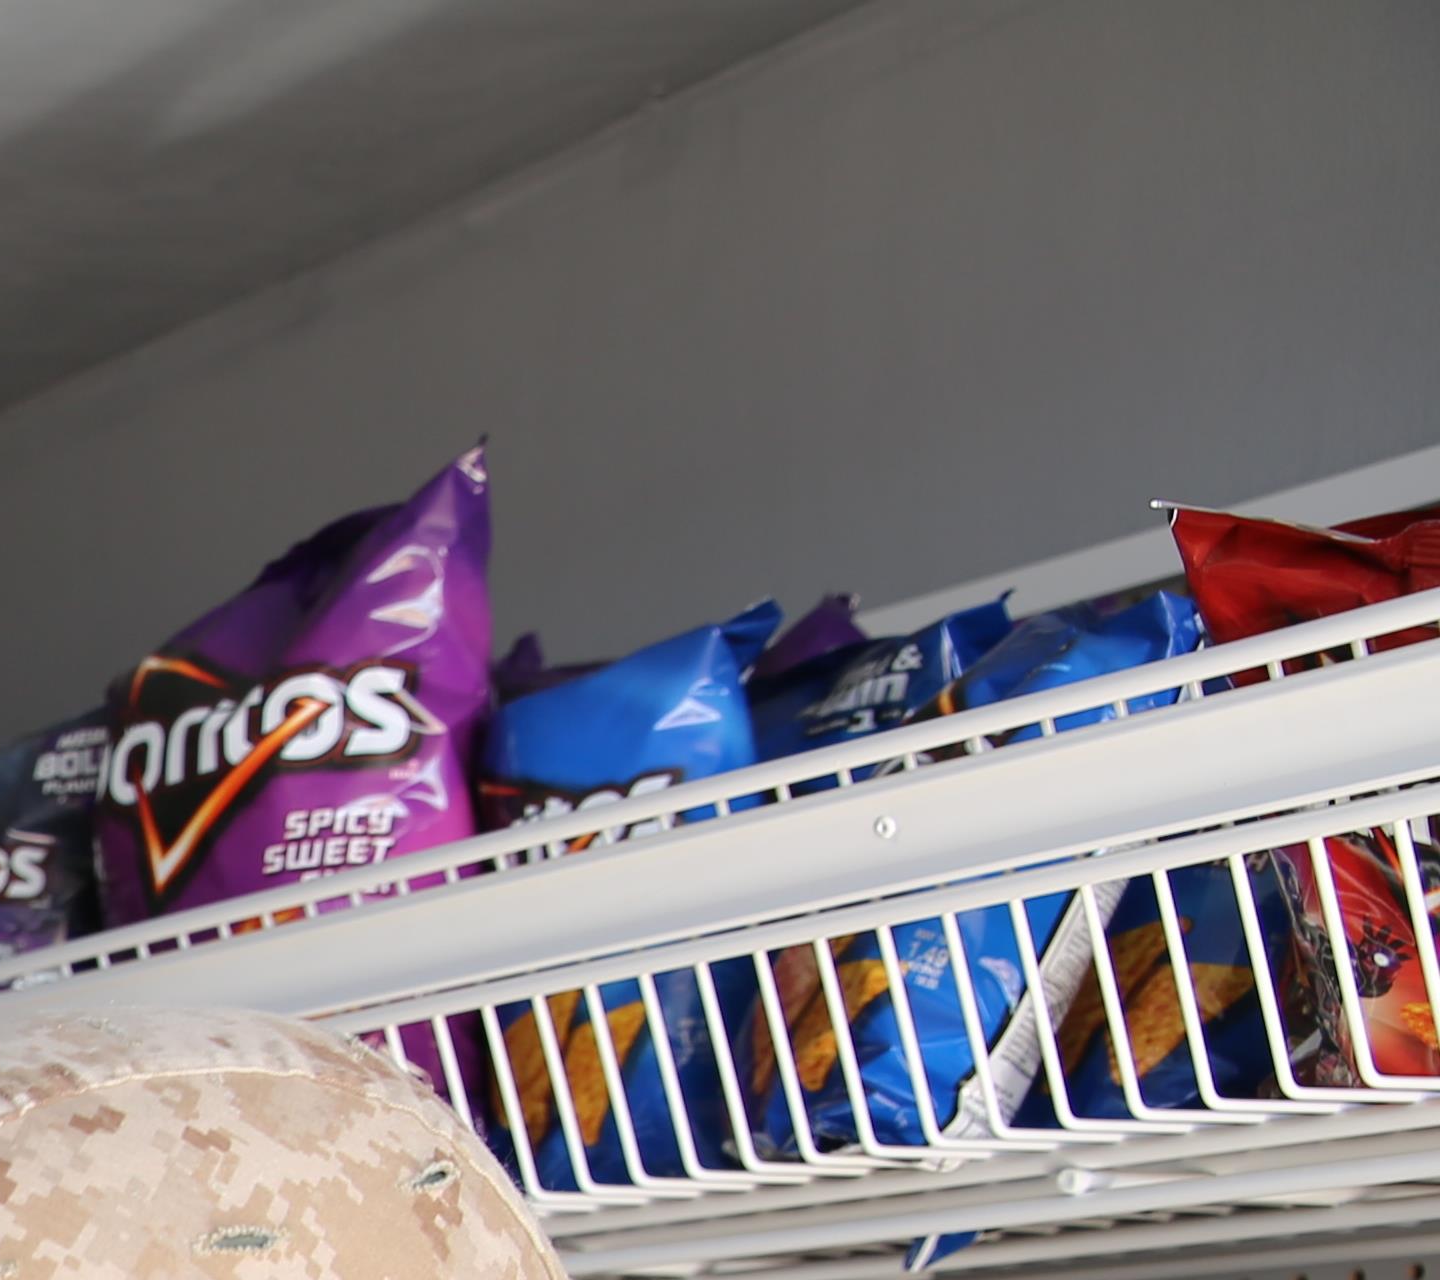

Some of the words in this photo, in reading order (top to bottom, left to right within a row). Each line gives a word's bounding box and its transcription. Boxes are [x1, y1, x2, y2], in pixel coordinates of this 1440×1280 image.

[98, 665, 411, 806] oritos
[283, 804, 397, 842] SPICY
[262, 835, 396, 875] SWEET
